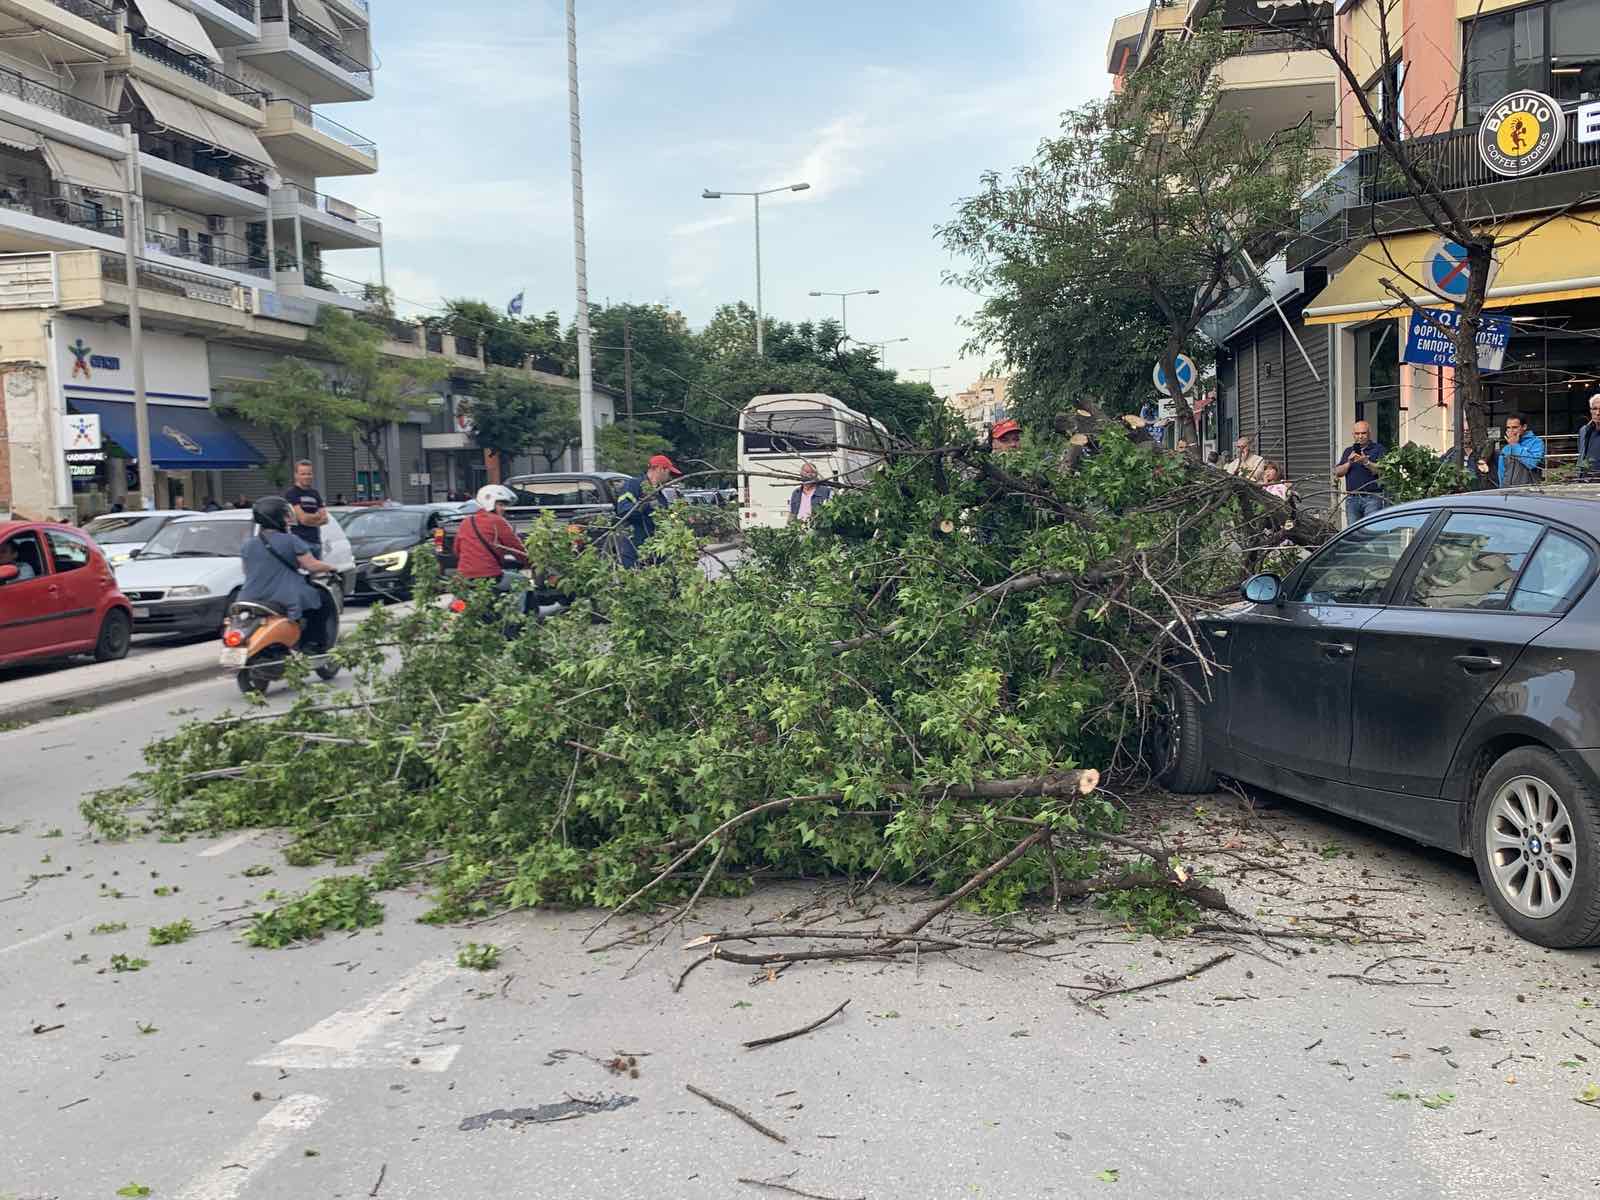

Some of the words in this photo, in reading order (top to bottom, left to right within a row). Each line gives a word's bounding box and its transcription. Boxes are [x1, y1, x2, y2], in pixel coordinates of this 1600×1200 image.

[1486, 98, 1551, 132] BRUNO
[1487, 144, 1518, 168] COFFEE
[1520, 132, 1550, 166] STORES
